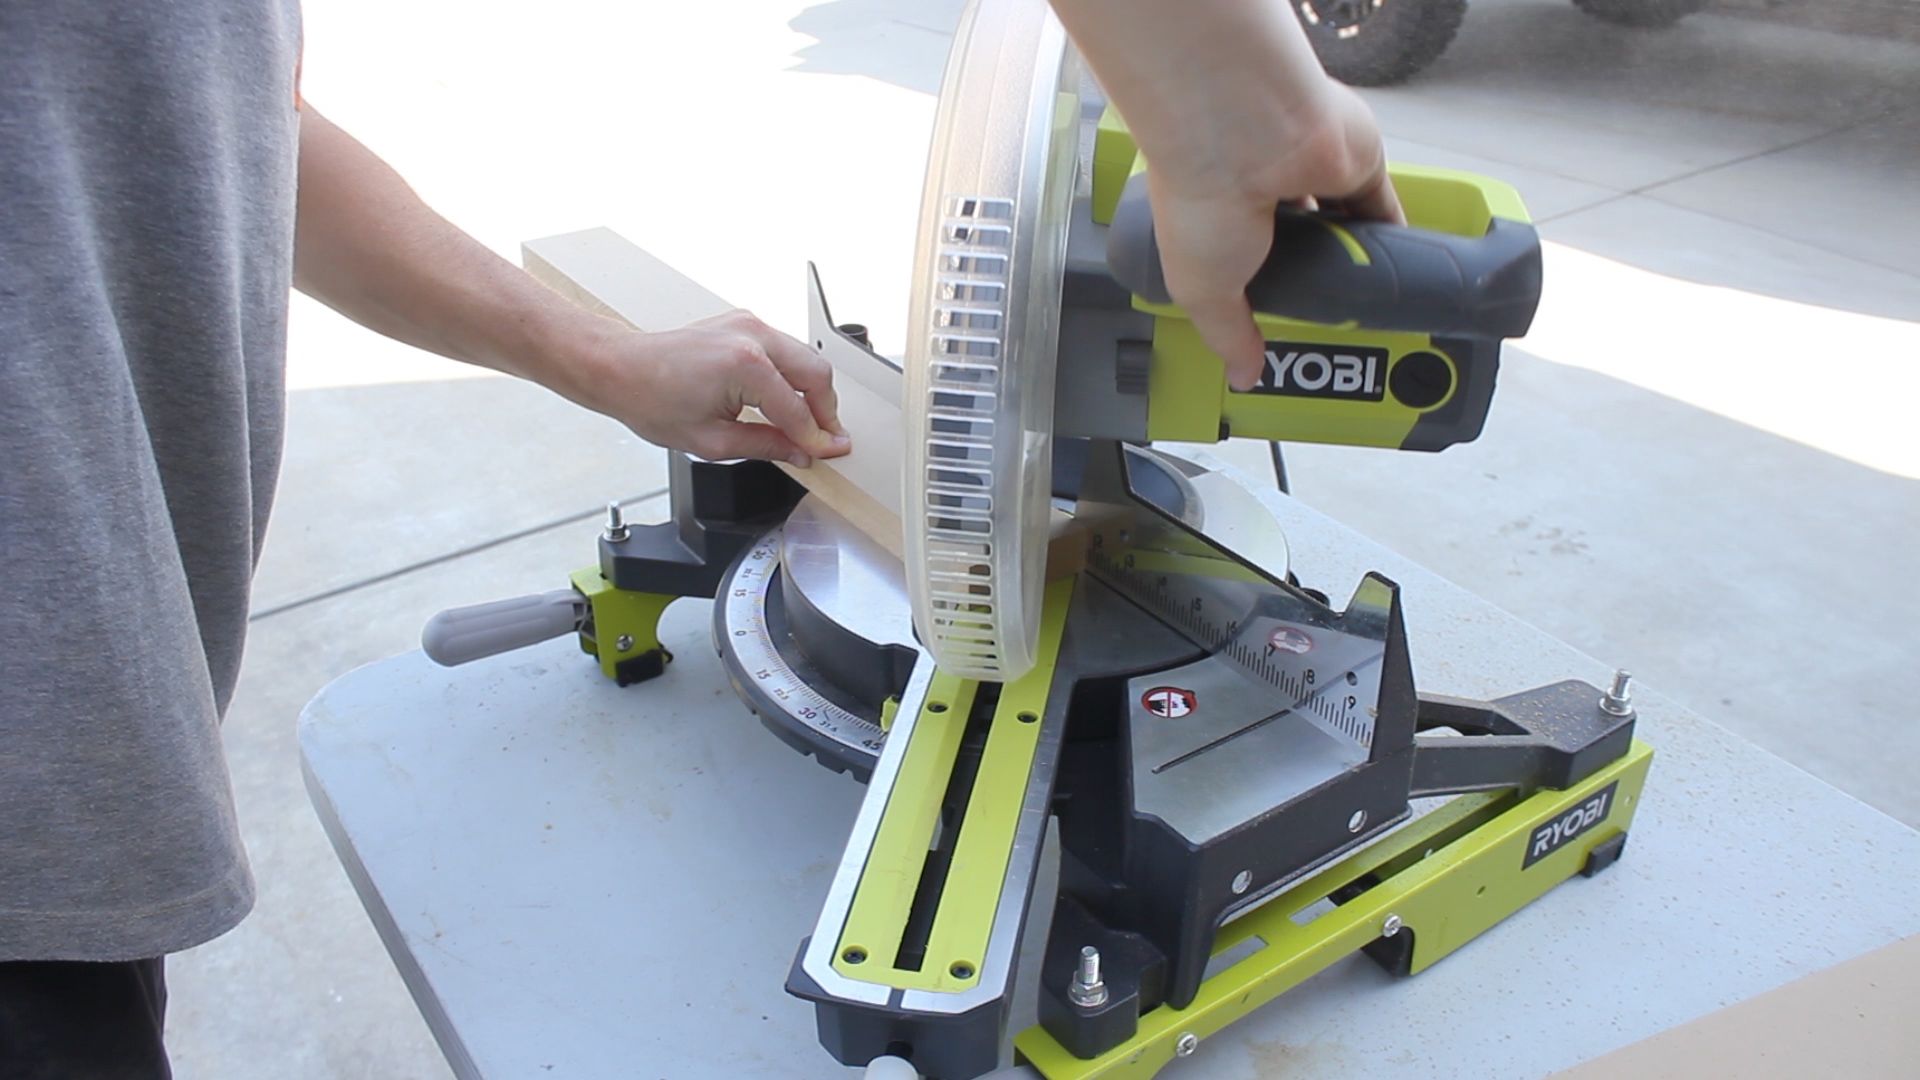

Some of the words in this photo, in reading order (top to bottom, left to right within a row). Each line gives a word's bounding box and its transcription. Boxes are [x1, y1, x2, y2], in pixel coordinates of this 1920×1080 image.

[1267, 643, 1276, 657] 7
[756, 669, 771, 680] 15
[1306, 669, 1315, 684] 8
[1348, 695, 1356, 709] 9
[798, 707, 817, 719] 30
[861, 739, 884, 751] 45
[1533, 793, 1607, 857] RYOBI
